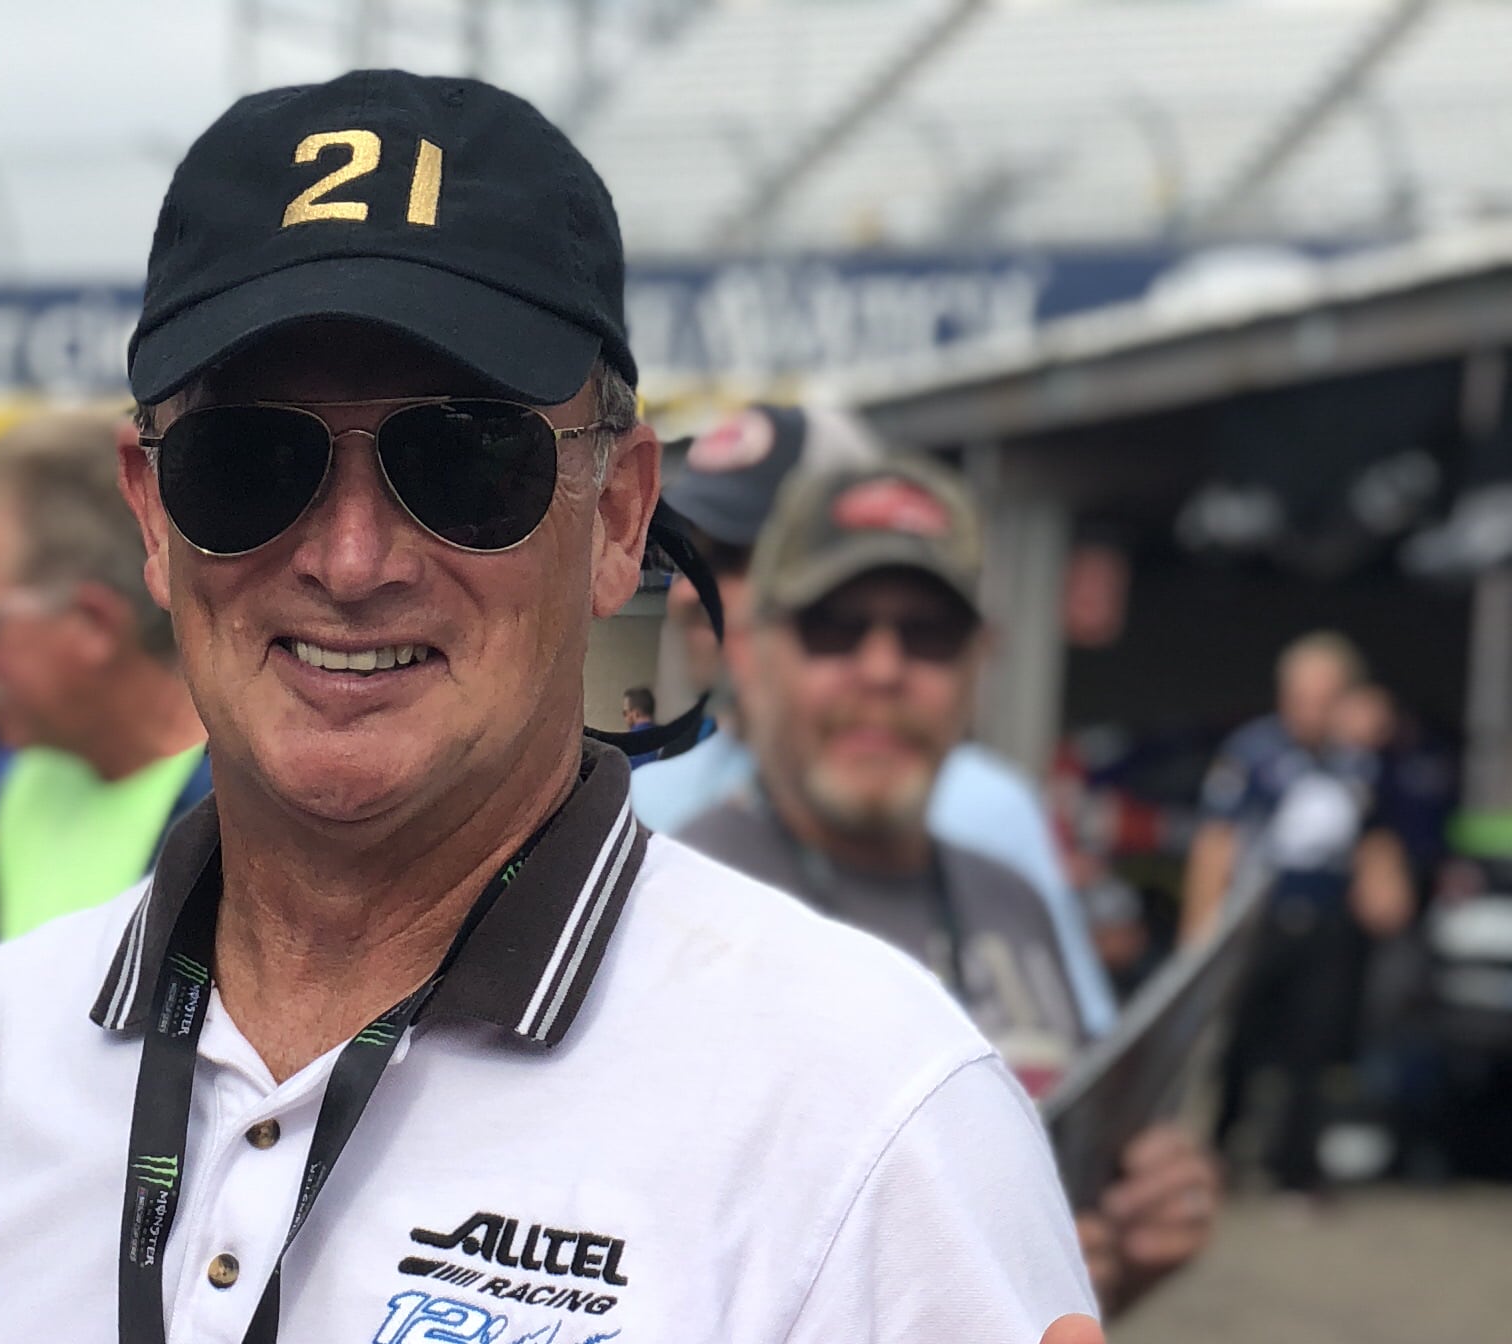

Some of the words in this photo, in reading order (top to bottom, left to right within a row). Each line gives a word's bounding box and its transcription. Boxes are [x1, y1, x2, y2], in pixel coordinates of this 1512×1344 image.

[280, 129, 444, 228] 21
[410, 1211, 628, 1286] ALLTEL
[477, 1276, 619, 1315] RACING
